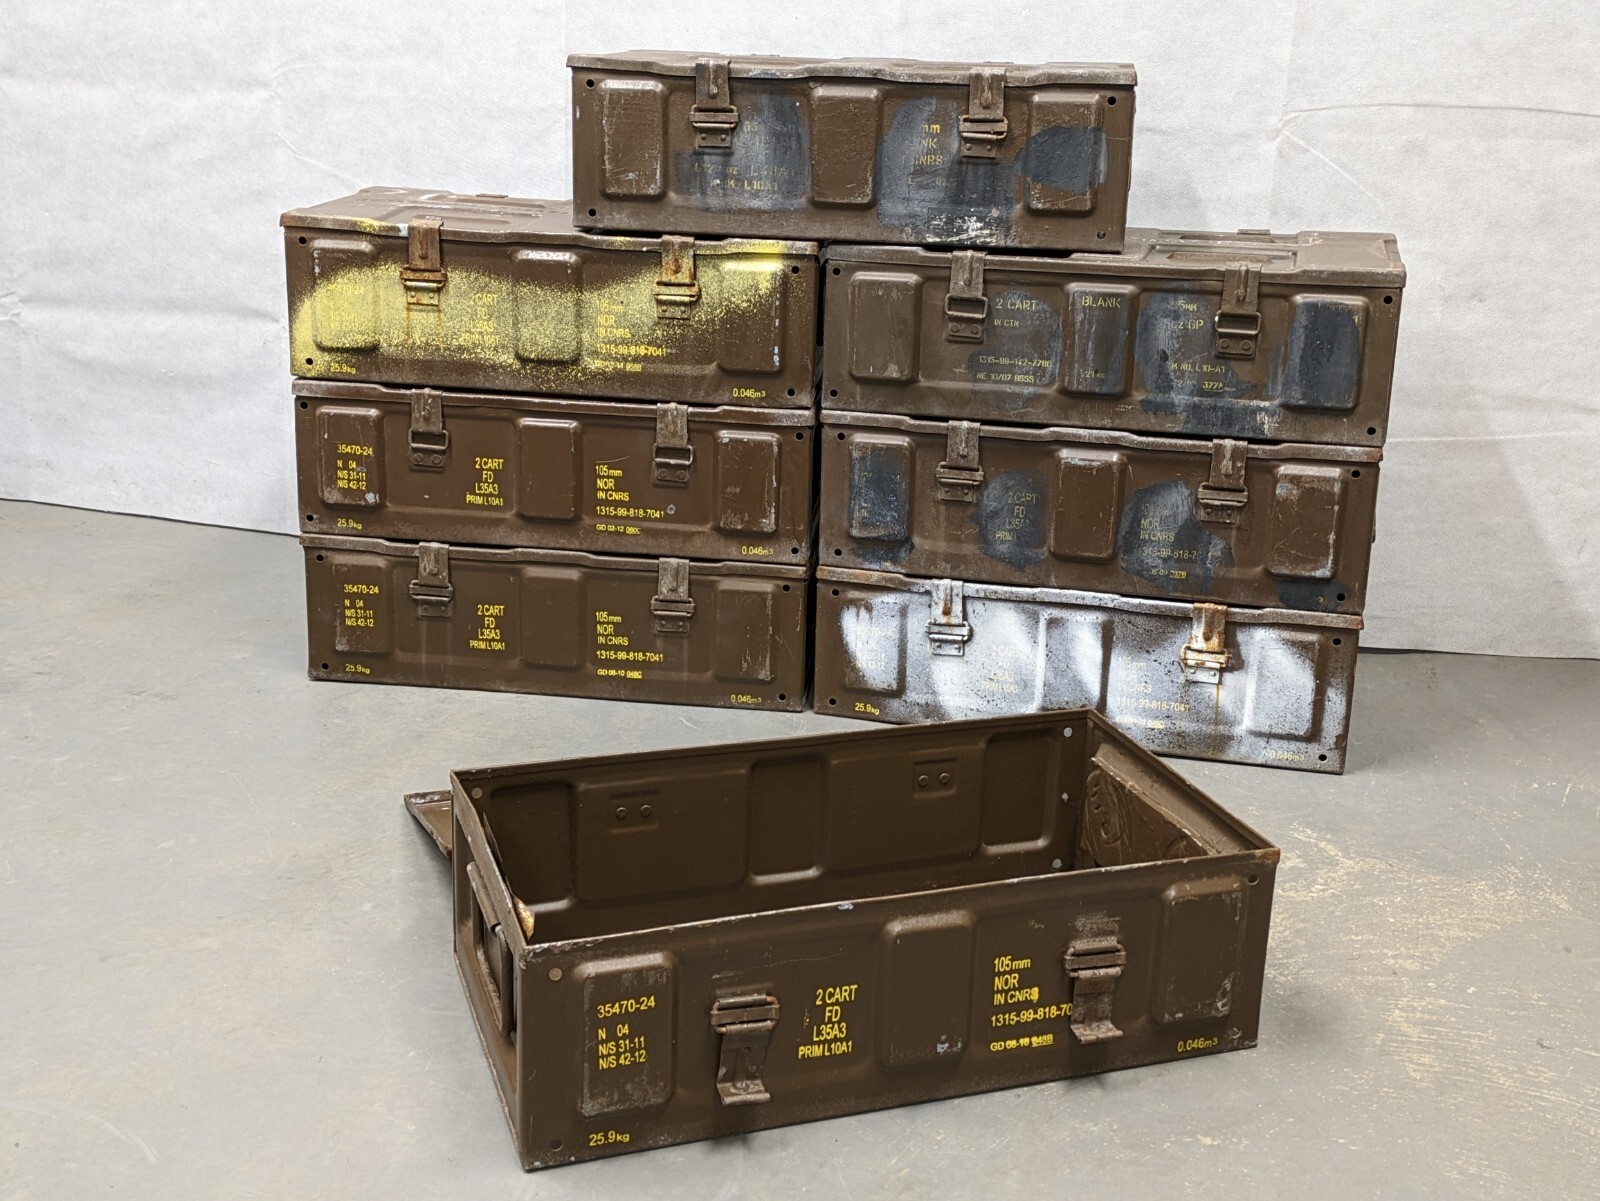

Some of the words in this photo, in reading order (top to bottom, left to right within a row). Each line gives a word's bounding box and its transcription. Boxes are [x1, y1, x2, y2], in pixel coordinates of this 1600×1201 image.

[995, 298, 1003, 309] 2
[1007, 299, 1037, 311] CART
[1081, 295, 1121, 308] BLANK
[597, 314, 616, 326] NOR
[1188, 319, 1204, 330] GP
[330, 363, 356, 375] 25.9kg
[336, 444, 373, 456] 35470-24
[337, 460, 343, 468] N
[348, 460, 357, 469] 04
[475, 457, 481, 469] 2
[481, 457, 504, 470] CART
[337, 470, 349, 479] N/S
[349, 471, 366, 480] 31-11
[482, 470, 494, 483] FD
[595, 464, 623, 477] 105mm
[337, 480, 349, 489] N/S
[349, 481, 367, 490] 42-12
[475, 482, 499, 495] L35A3
[596, 478, 615, 490] NOR
[466, 494, 483, 505] PRIM
[483, 496, 503, 507] L10A1
[597, 490, 606, 500] IN
[606, 491, 630, 502] CNRS
[595, 505, 665, 519] 1315-99-818-7041
[1014, 505, 1026, 518] FD
[337, 518, 363, 530] 25.9kg
[595, 524, 607, 532] GD
[607, 524, 625, 533] 02-12
[1140, 519, 1159, 530] NOR
[1140, 530, 1149, 541] IN
[1150, 532, 1175, 543] CNRS
[343, 584, 379, 594] 35470-24
[345, 599, 350, 607] N
[356, 599, 364, 608] 04
[345, 609, 356, 617] N/S
[357, 609, 373, 618] 31-11
[477, 604, 483, 616] 2
[483, 604, 505, 617] CART
[346, 618, 357, 627] N/S
[357, 619, 374, 628] 42-12
[484, 617, 496, 629] FD
[595, 611, 622, 623] 105mm
[478, 628, 501, 640] L35A3
[596, 624, 614, 635] NOR
[469, 640, 486, 650] PRIM
[486, 641, 505, 651] L10A1
[597, 636, 606, 645] IN
[606, 636, 629, 646] CNRS
[596, 650, 664, 662] 1315-99-818-7041
[345, 664, 371, 675] 25.9kg
[597, 668, 608, 676] GD
[854, 702, 880, 716] 25.9kg
[993, 955, 1031, 973] 105mm
[994, 973, 1019, 991] NOR
[815, 988, 823, 1006] 2
[825, 984, 858, 1004] CART
[993, 993, 1005, 1005] IN
[597, 995, 656, 1018] 35470-24
[825, 1005, 841, 1023] FD
[991, 1003, 1073, 1027] 1315-99-818-70
[598, 1027, 606, 1040] N
[616, 1023, 630, 1037] 04
[813, 1022, 847, 1042] L35A3
[598, 1041, 616, 1056] N/S
[618, 1035, 645, 1052] 31-11
[798, 1044, 824, 1059] PRIM
[824, 1040, 853, 1056] L10A1
[990, 1041, 1005, 1051] GD
[599, 1055, 617, 1070] N/S
[618, 1049, 646, 1066] 42-12
[589, 1130, 630, 1146] 25.9kg
